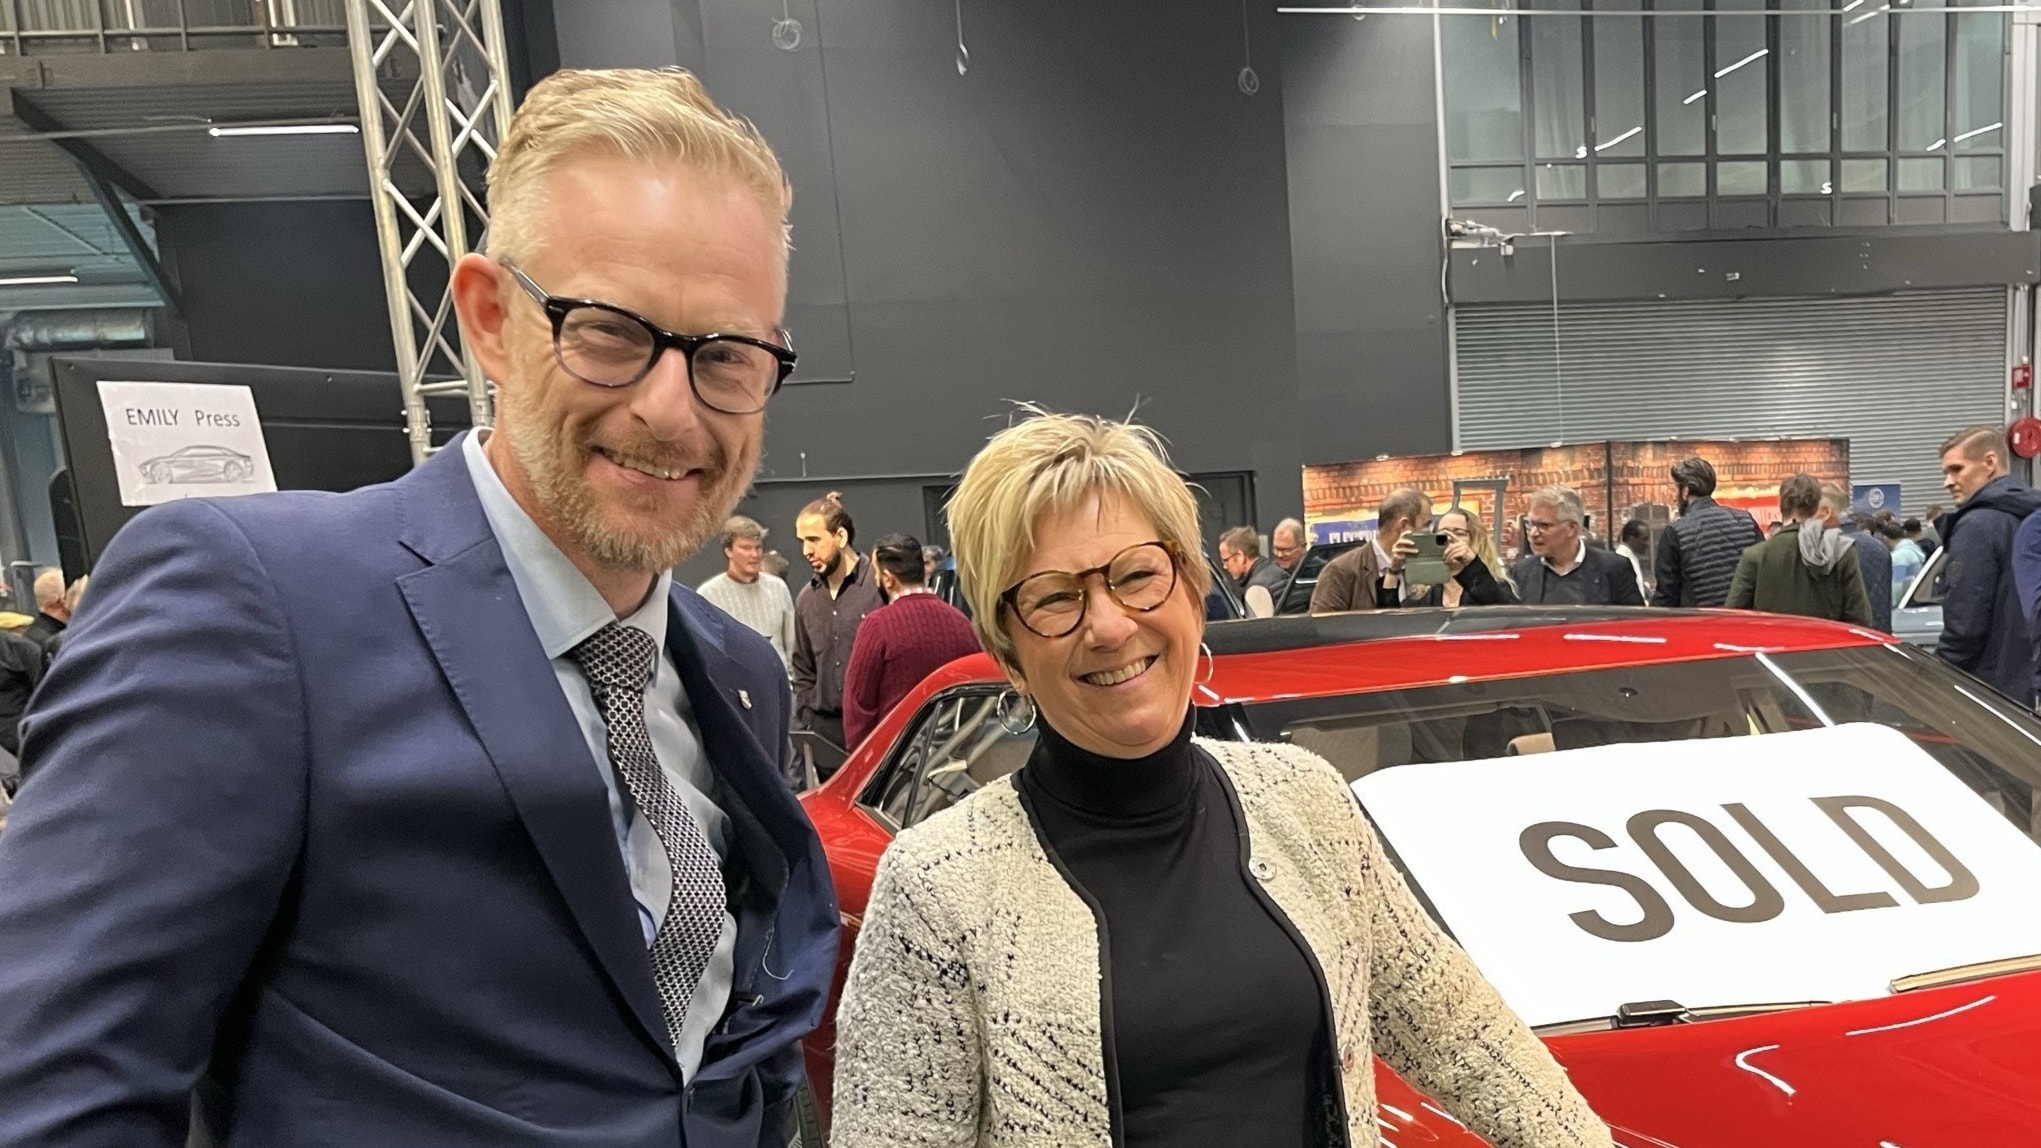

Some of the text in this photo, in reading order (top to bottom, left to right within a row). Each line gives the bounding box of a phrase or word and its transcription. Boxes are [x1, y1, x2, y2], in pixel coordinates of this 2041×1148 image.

[126, 408, 241, 428] EMILY Press
[1519, 795, 1981, 942] SOLD
